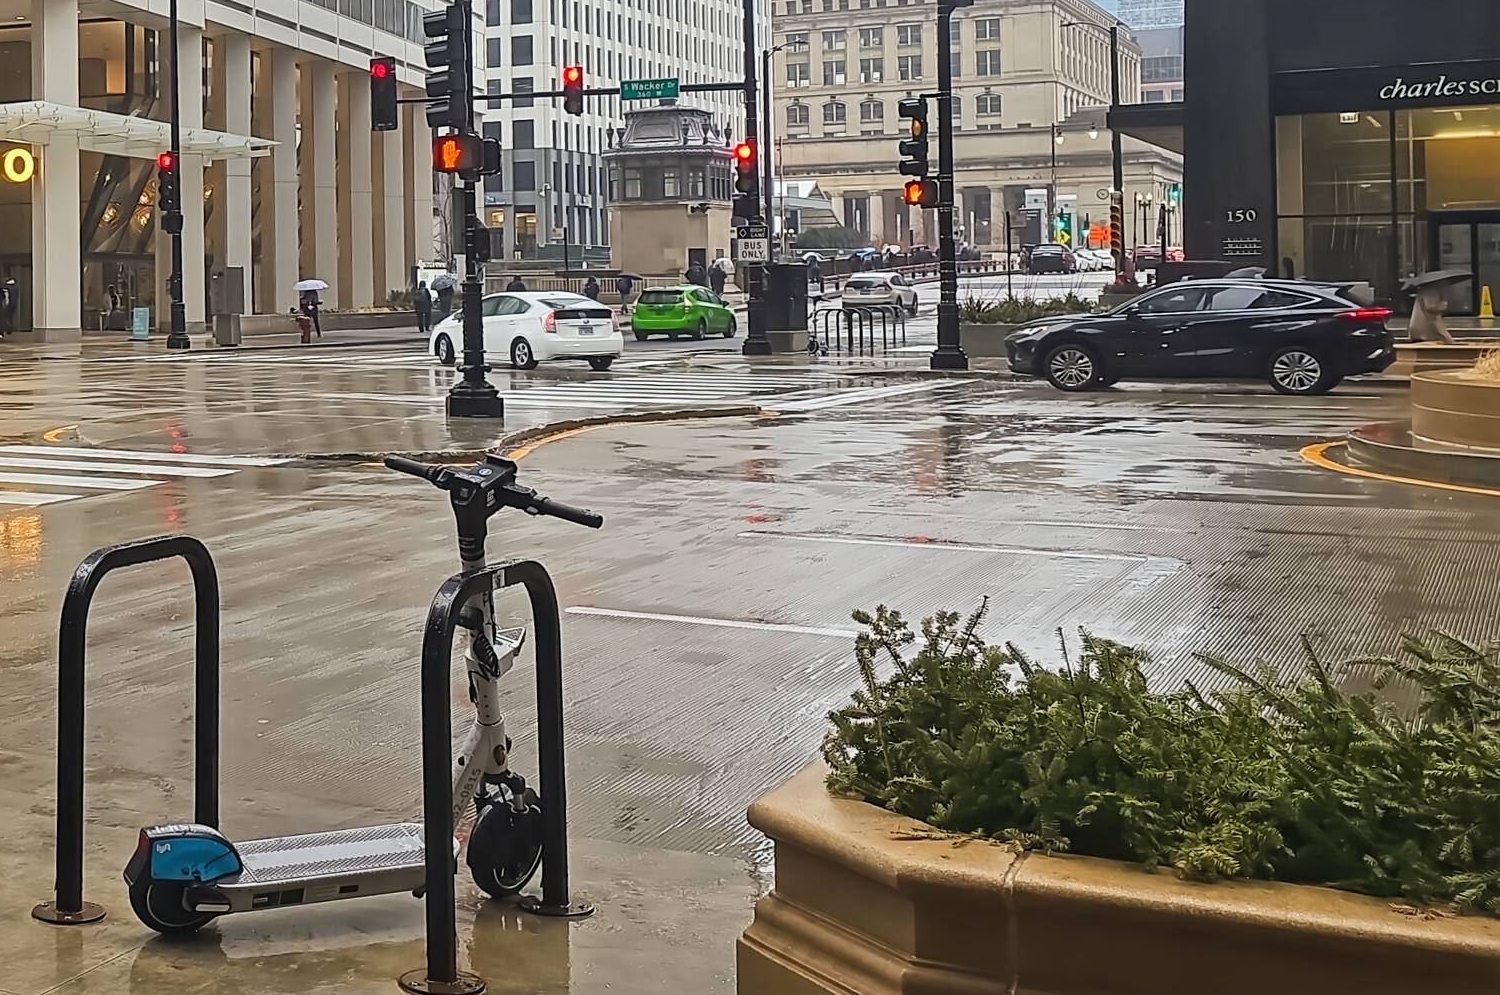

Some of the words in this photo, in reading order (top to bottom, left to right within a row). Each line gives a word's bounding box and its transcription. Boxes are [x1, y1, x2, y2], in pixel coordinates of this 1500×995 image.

[631, 81, 666, 91] Wacker
[1379, 75, 1468, 99] charles
[1227, 209, 1257, 223] 150
[743, 241, 762, 250] BUS
[741, 250, 764, 259] ONLY
